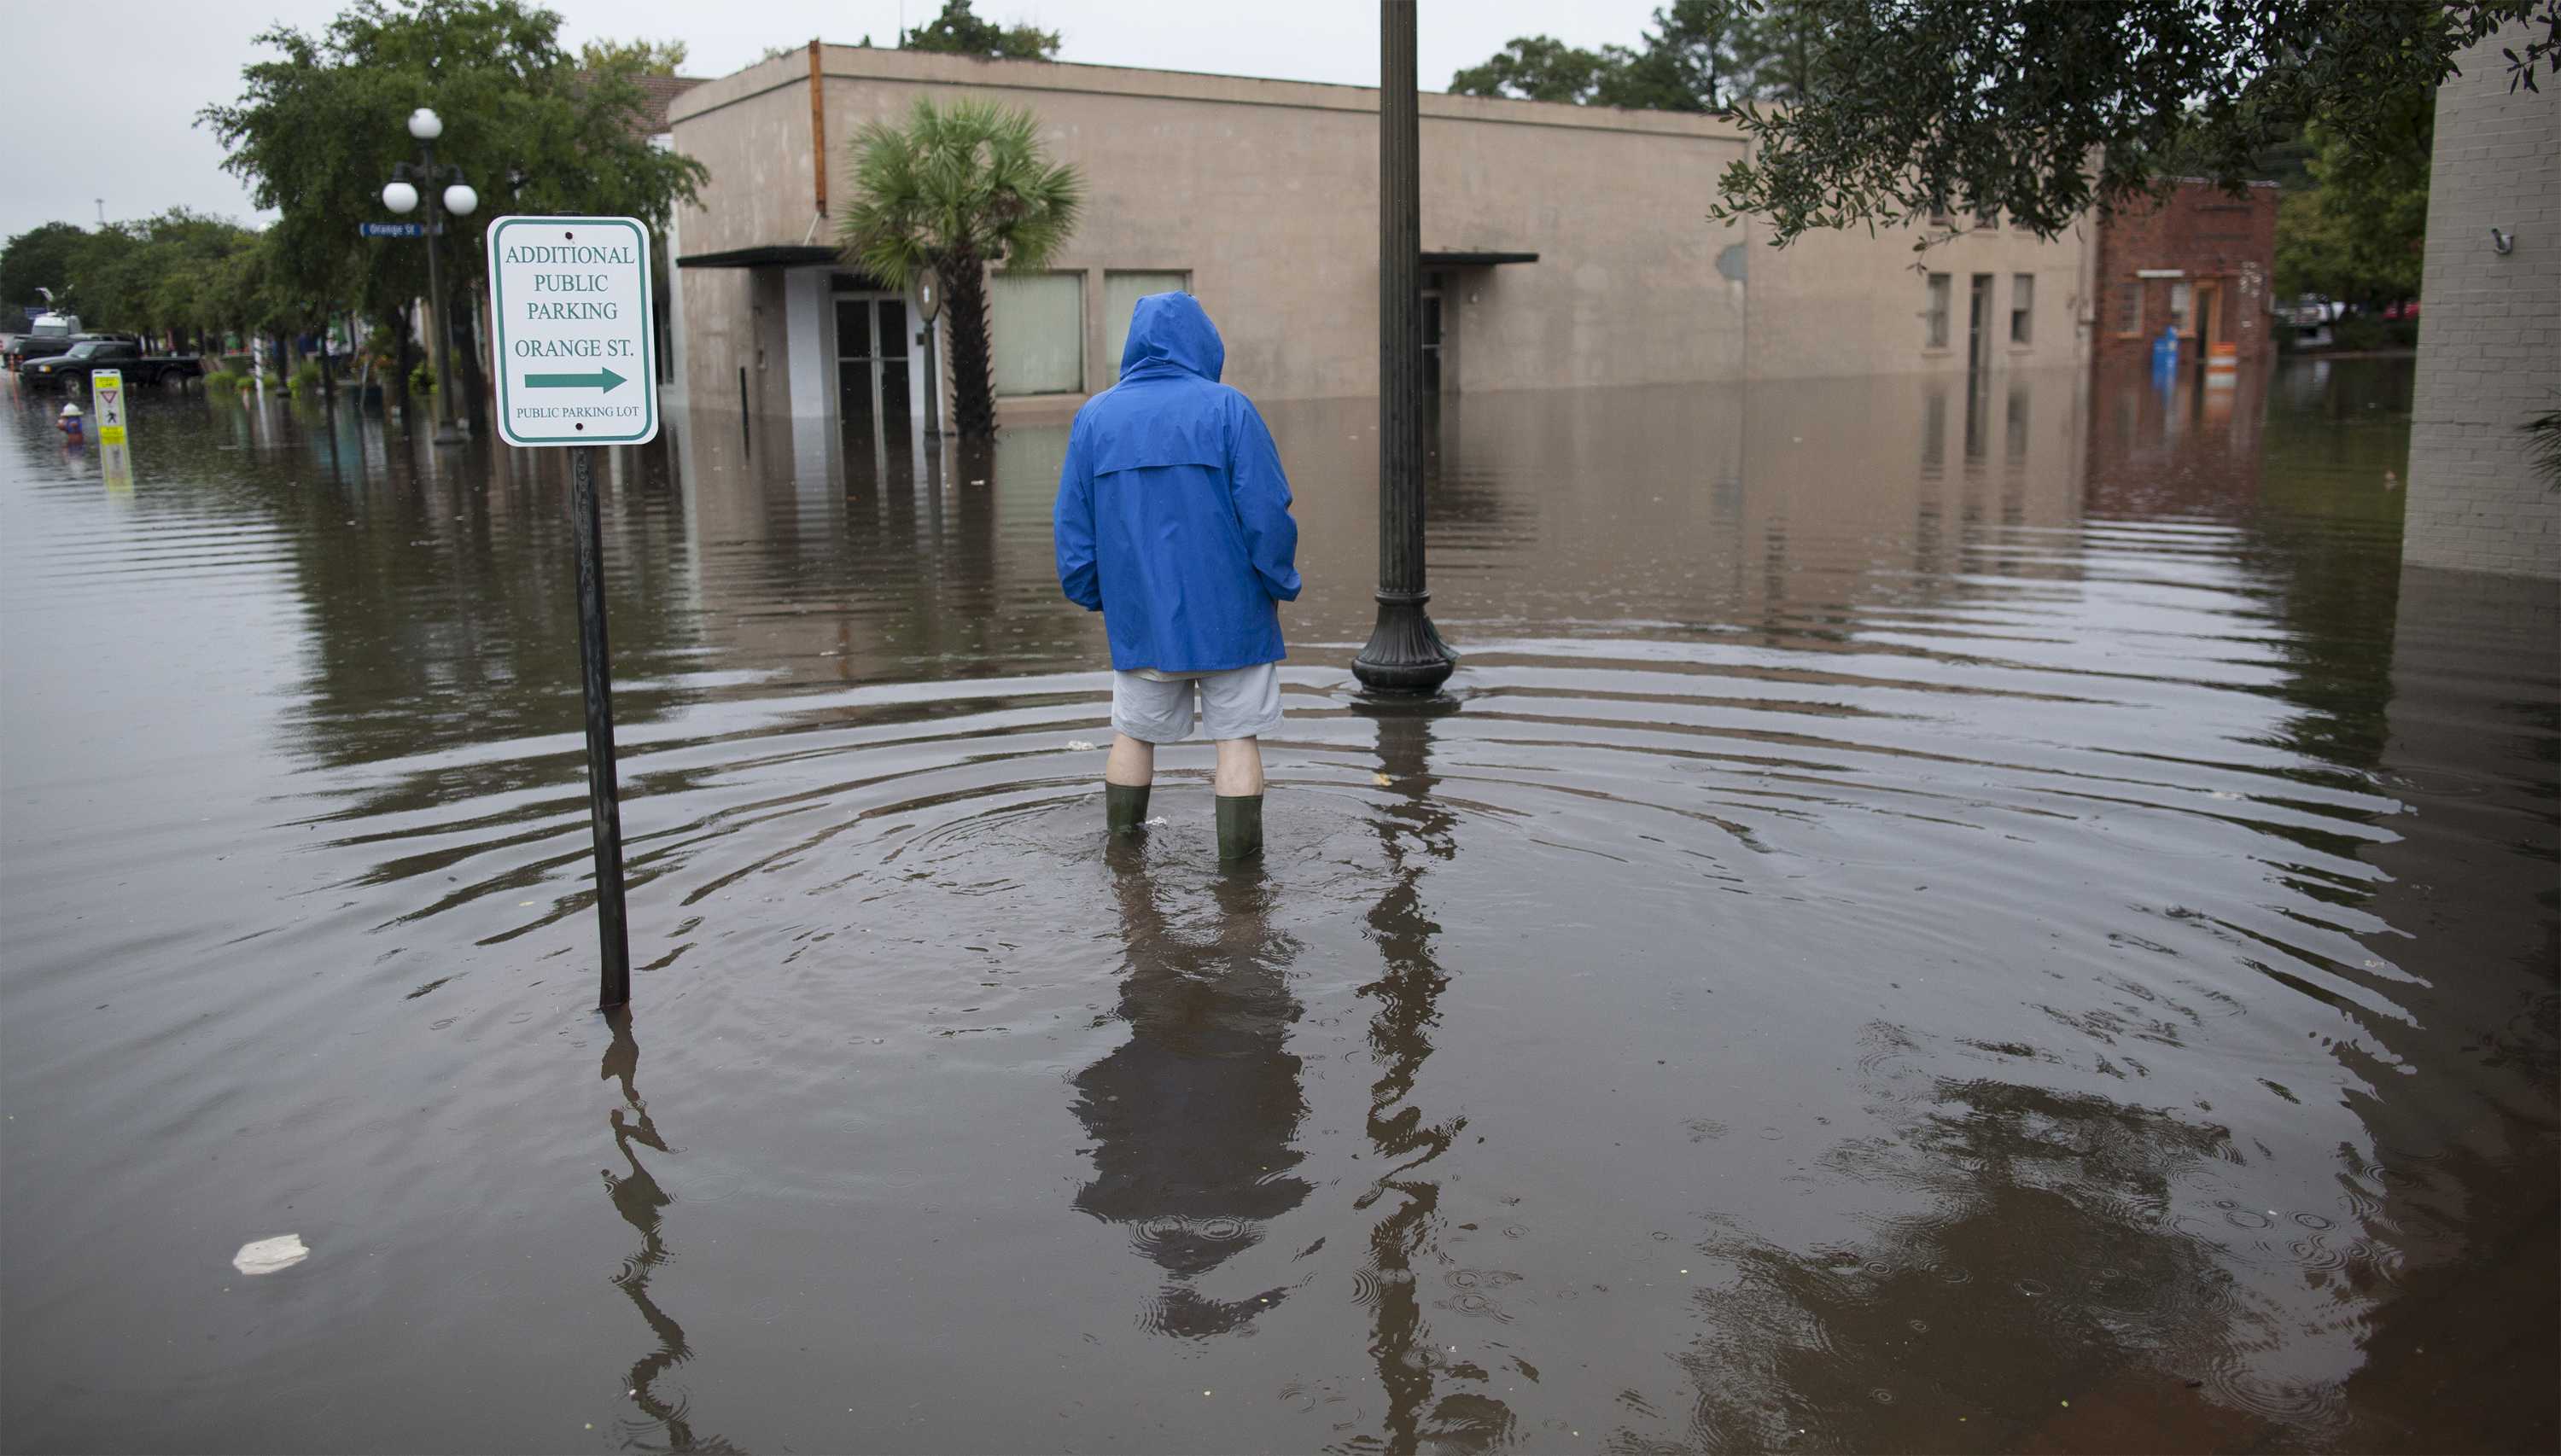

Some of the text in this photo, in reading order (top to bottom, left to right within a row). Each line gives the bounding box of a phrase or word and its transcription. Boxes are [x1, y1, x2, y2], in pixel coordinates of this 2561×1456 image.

[505, 246, 635, 265] ADDITIONAL
[534, 274, 609, 292] PUBLIC
[527, 302, 618, 320] PARKING
[515, 339, 634, 357] ORANGE ST.
[516, 405, 639, 418] PUBLIC PARKING LOT
